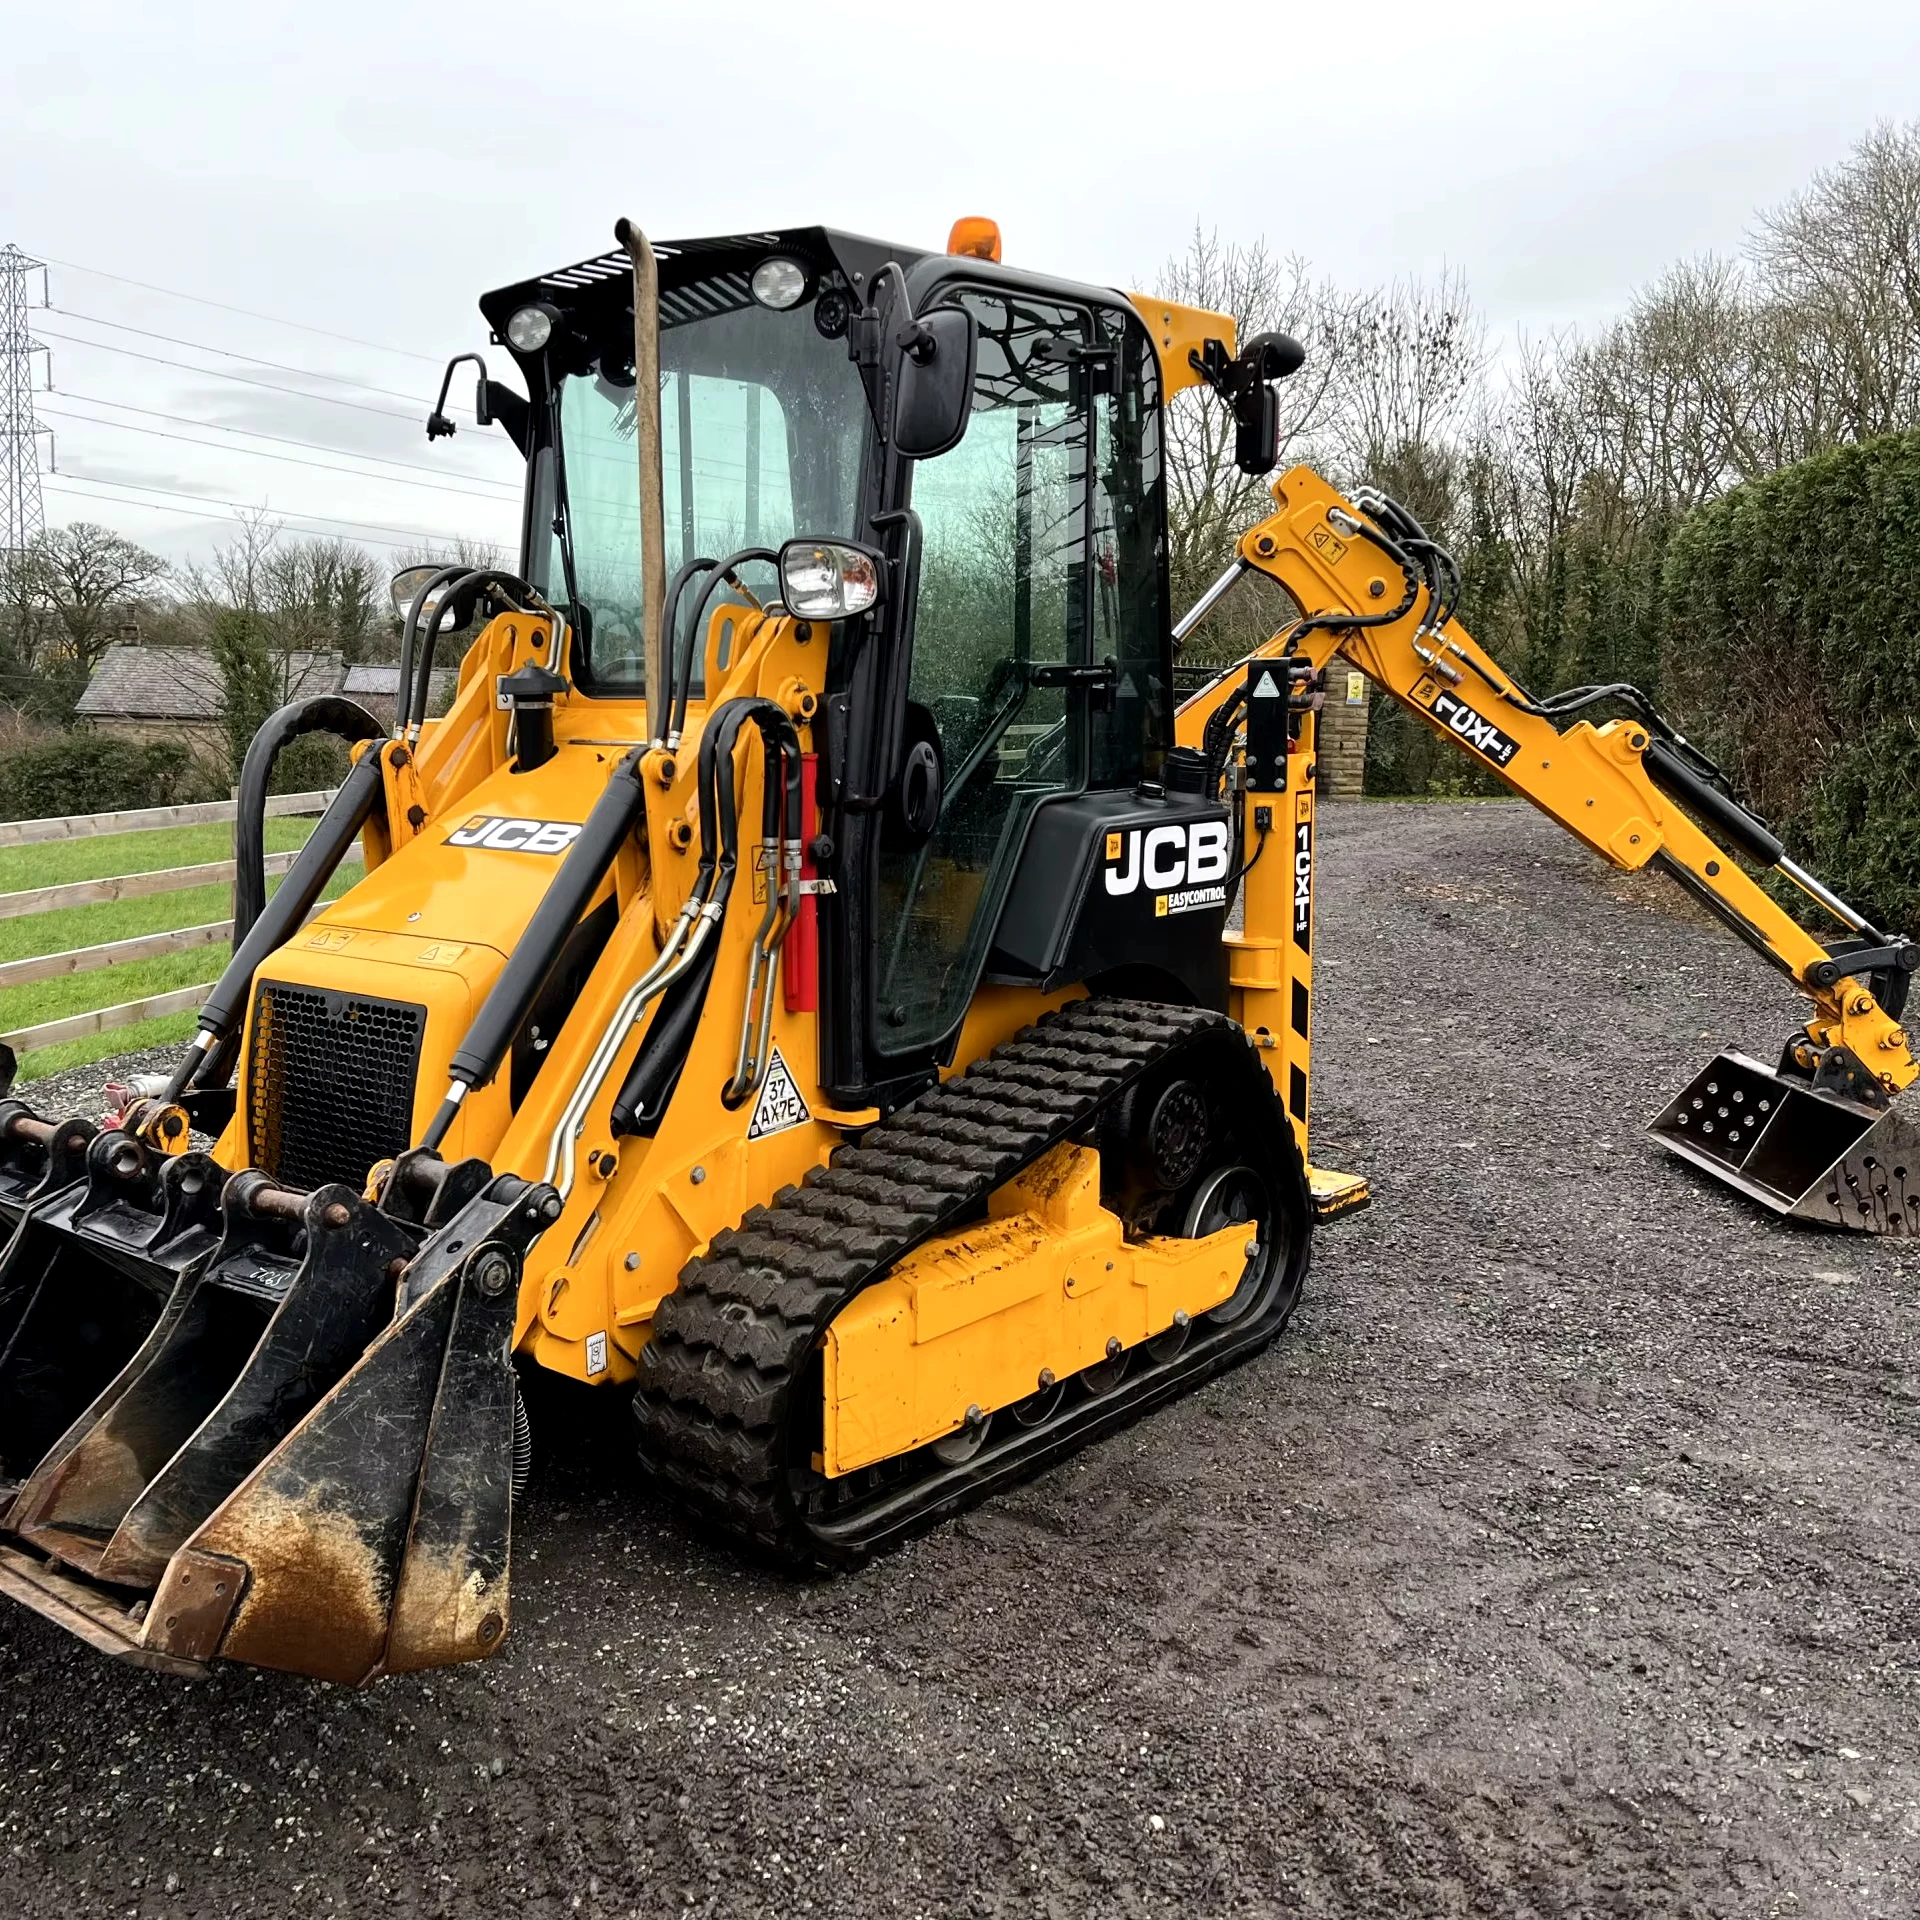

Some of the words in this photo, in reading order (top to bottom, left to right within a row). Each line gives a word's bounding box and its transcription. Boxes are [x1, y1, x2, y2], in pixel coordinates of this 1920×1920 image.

[1435, 695, 1503, 751] 1CXT
[1498, 744, 1513, 762] HF
[449, 818, 583, 852] JCB
[1105, 821, 1228, 896] JCB
[1294, 825, 1311, 921] 1CXT
[1168, 886, 1226, 909] EASYCONTROL
[1296, 921, 1308, 932] HF
[769, 1078, 786, 1101] 37
[761, 1097, 797, 1126] AX7E
